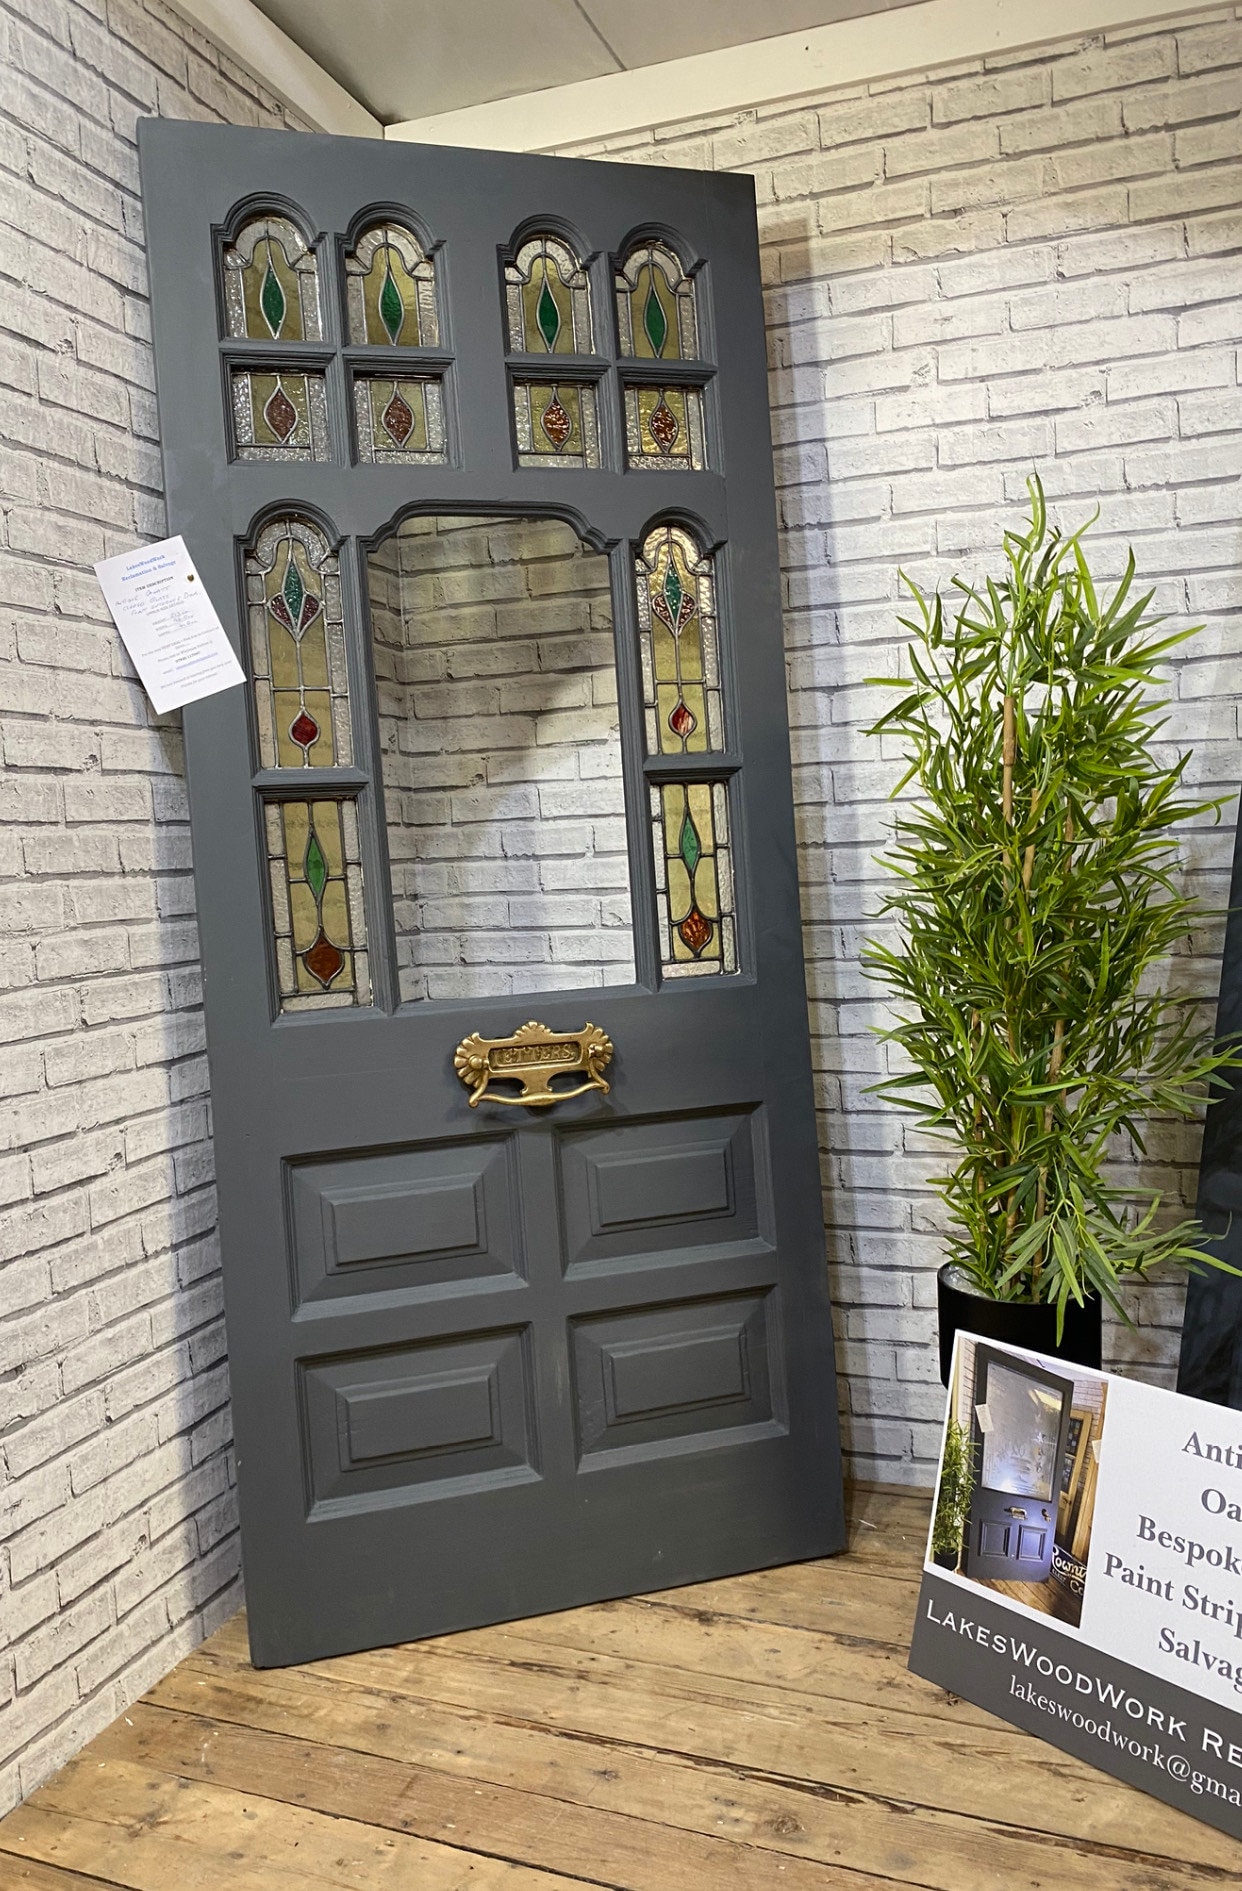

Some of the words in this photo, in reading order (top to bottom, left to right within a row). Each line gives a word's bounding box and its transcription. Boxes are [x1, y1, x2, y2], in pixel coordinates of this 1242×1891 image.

[1201, 1488, 1242, 1523] Oa
[1136, 1514, 1242, 1576] Bespok
[1103, 1552, 1174, 1602] Paint
[1009, 1675, 1242, 1806] lakeswoodwork@gma
